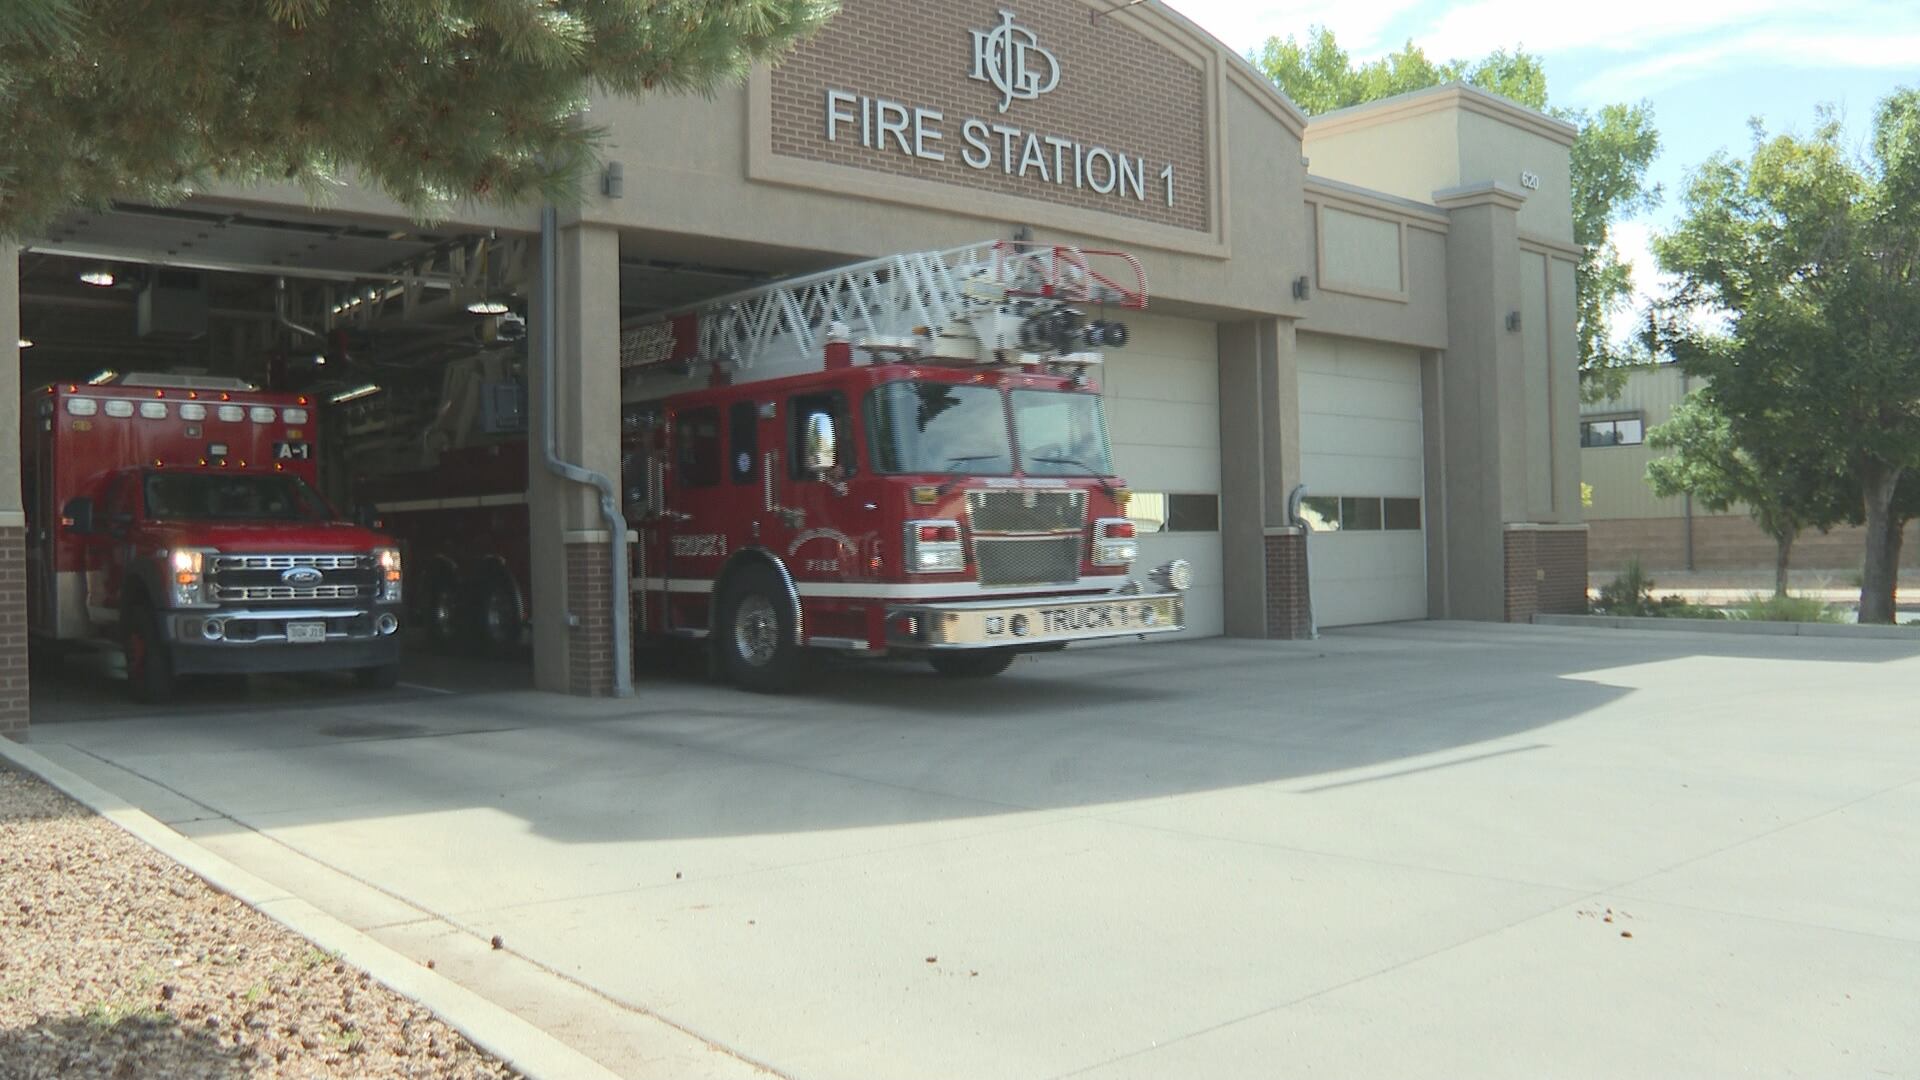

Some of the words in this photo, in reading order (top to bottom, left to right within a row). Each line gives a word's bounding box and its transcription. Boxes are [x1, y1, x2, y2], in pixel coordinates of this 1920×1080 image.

[825, 89, 945, 162] FIRE
[961, 118, 1145, 201] STATION
[1160, 164, 1174, 207] 1
[1521, 170, 1539, 190] 620
[279, 443, 308, 459] A-1
[671, 534, 718, 557] TRUCK
[1040, 605, 1114, 633] TRUCK
[1119, 605, 1130, 627] 1
